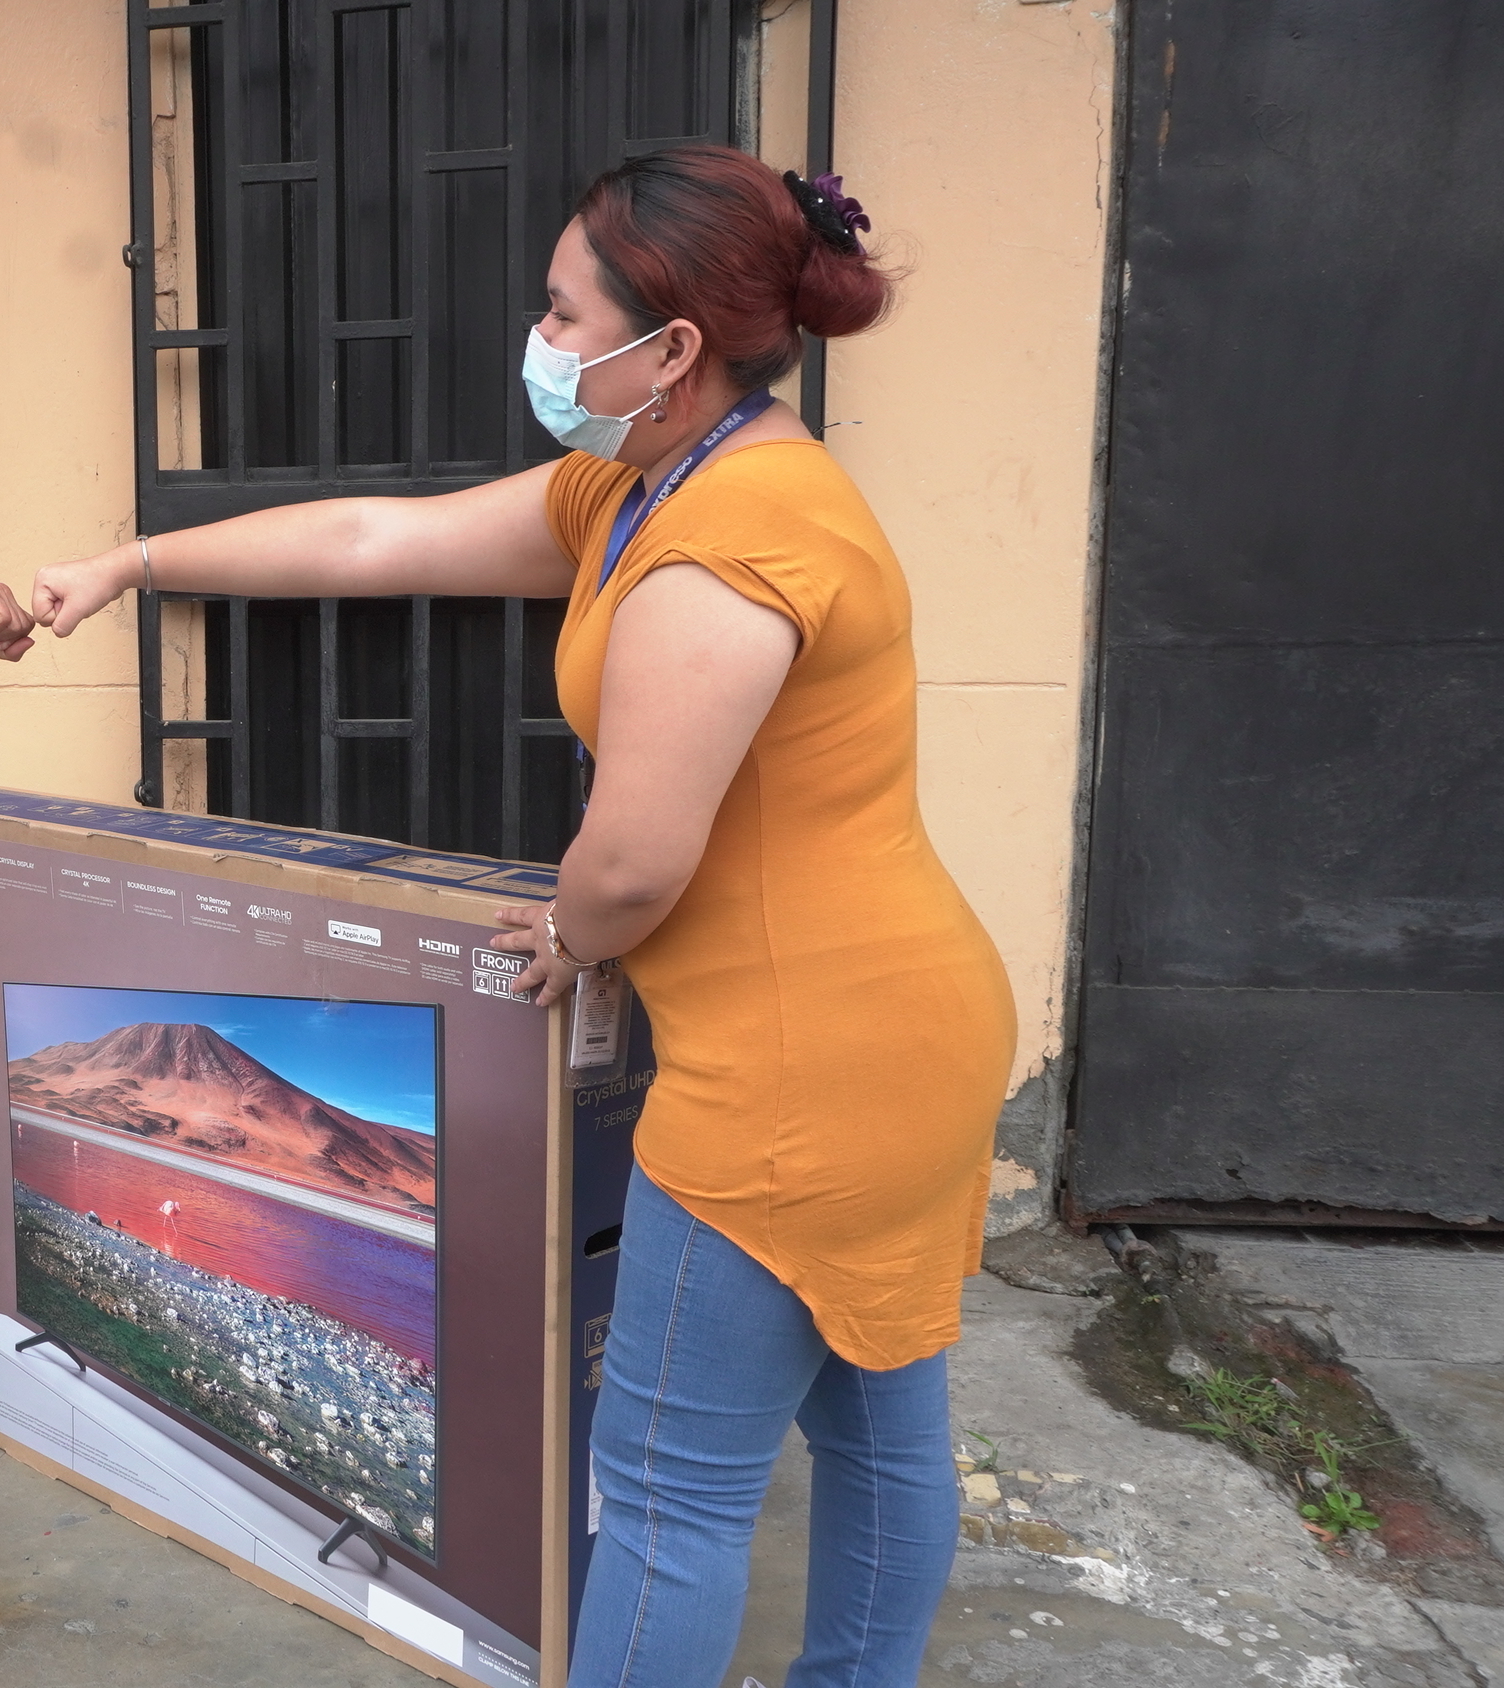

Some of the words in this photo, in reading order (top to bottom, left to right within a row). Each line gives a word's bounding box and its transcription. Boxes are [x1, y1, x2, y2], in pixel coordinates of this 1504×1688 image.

[702, 412, 744, 447] EXTRA
[17, 860, 35, 869] DISPLAY
[61, 868, 81, 878] CRYSTAL
[81, 873, 111, 884] PROCESSOR
[127, 881, 156, 893] BOUNDLESS
[157, 886, 176, 896] DESIGN
[196, 894, 208, 903] One
[209, 896, 232, 907] Remote
[200, 904, 228, 915] FUNCTION
[247, 905, 259, 919] 4K
[259, 906, 280, 917] ULTRA
[281, 909, 292, 920] HD
[259, 914, 292, 925] CONNECTED
[343, 930, 358, 940] Apple
[359, 933, 379, 944] AirPlay
[419, 937, 460, 955] HDMI
[481, 953, 523, 973] FRONT
[576, 1078, 626, 1109] Crystal
[630, 1069, 655, 1093] UHD
[594, 1117, 601, 1131] 7
[603, 1105, 638, 1129] SERIES
[478, 1640, 530, 1671] www.samsung.com
[494, 1664, 509, 1676] BELOW
[510, 1672, 519, 1682] THIS
[520, 1678, 530, 1687] LINE
